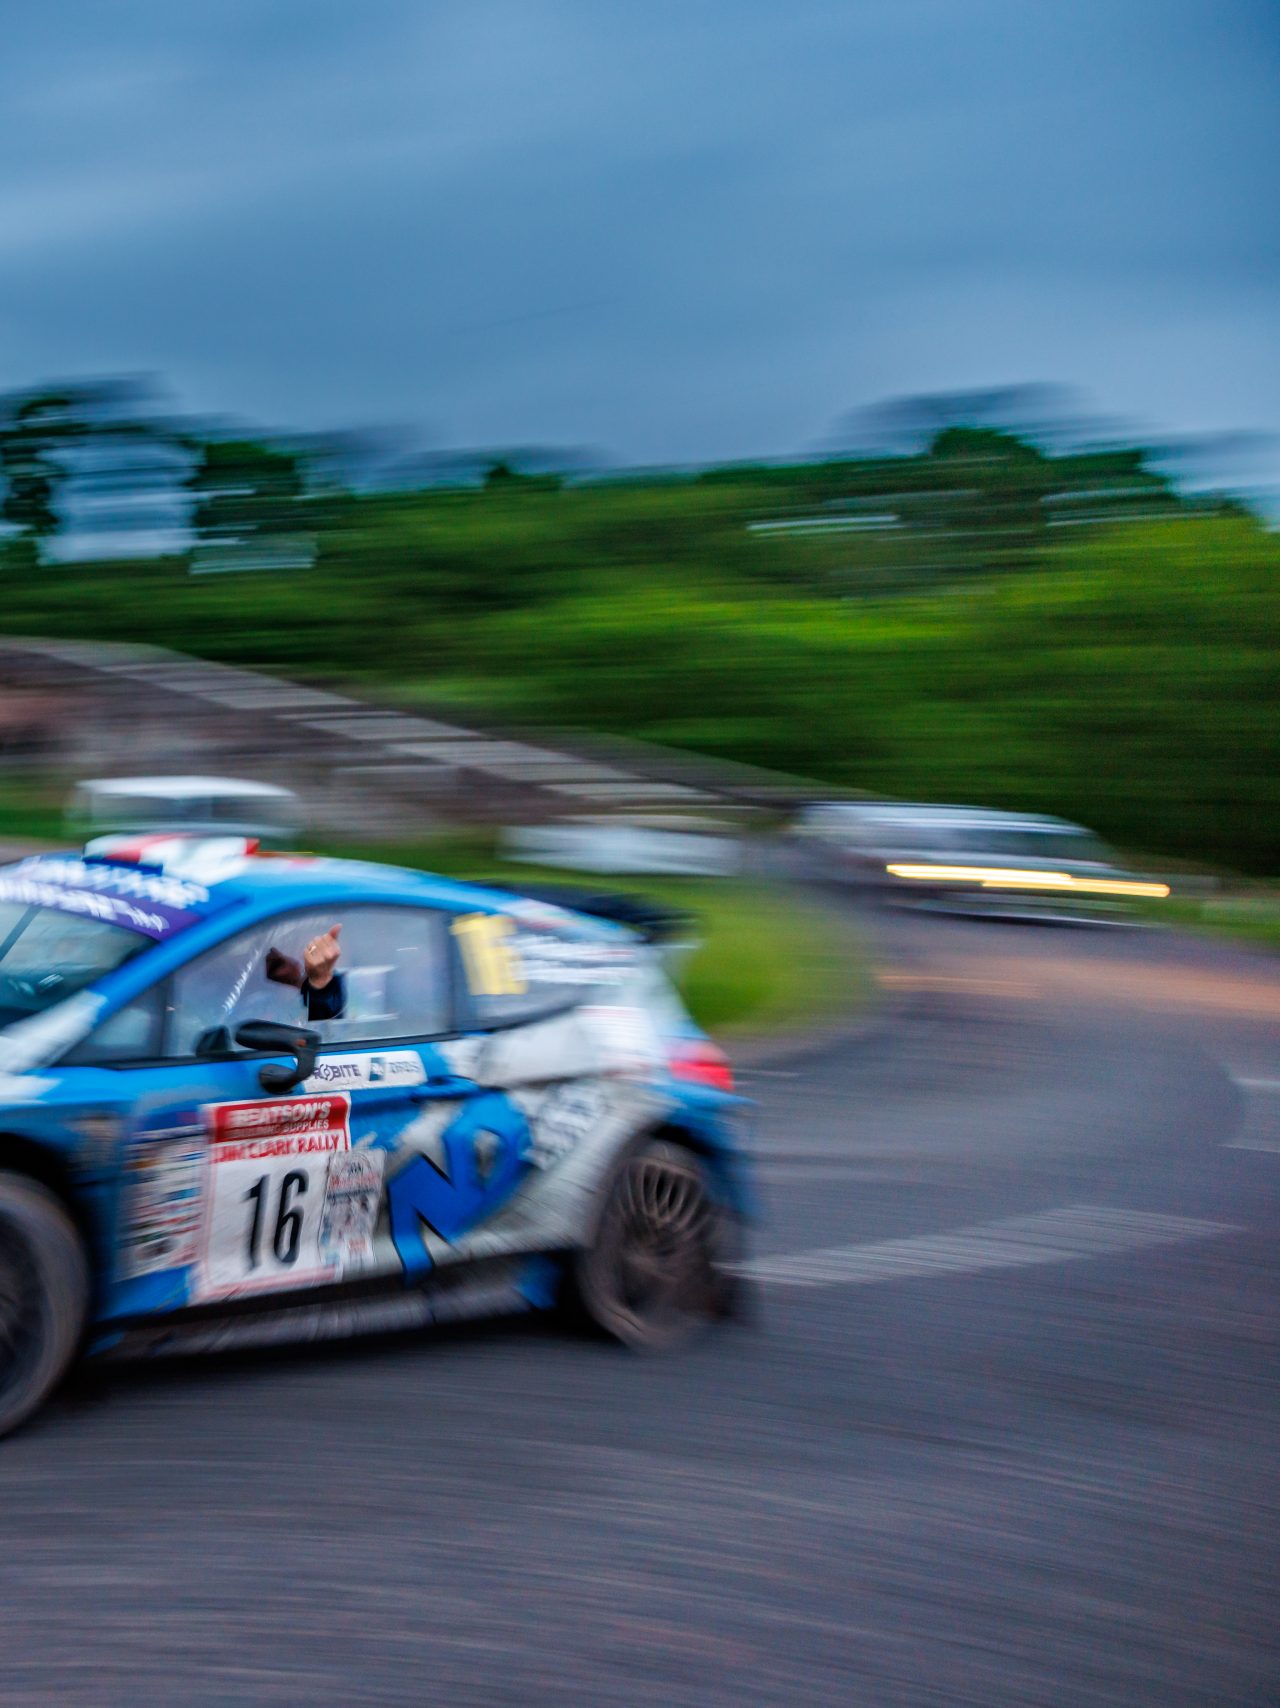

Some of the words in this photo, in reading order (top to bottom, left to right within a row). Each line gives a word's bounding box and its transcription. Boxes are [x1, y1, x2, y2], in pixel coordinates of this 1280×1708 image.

[282, 1119, 330, 1132] SUPPLIES
[247, 1138, 296, 1160] CLARK
[297, 1132, 340, 1153] RALLY
[241, 1168, 309, 1269] 16
